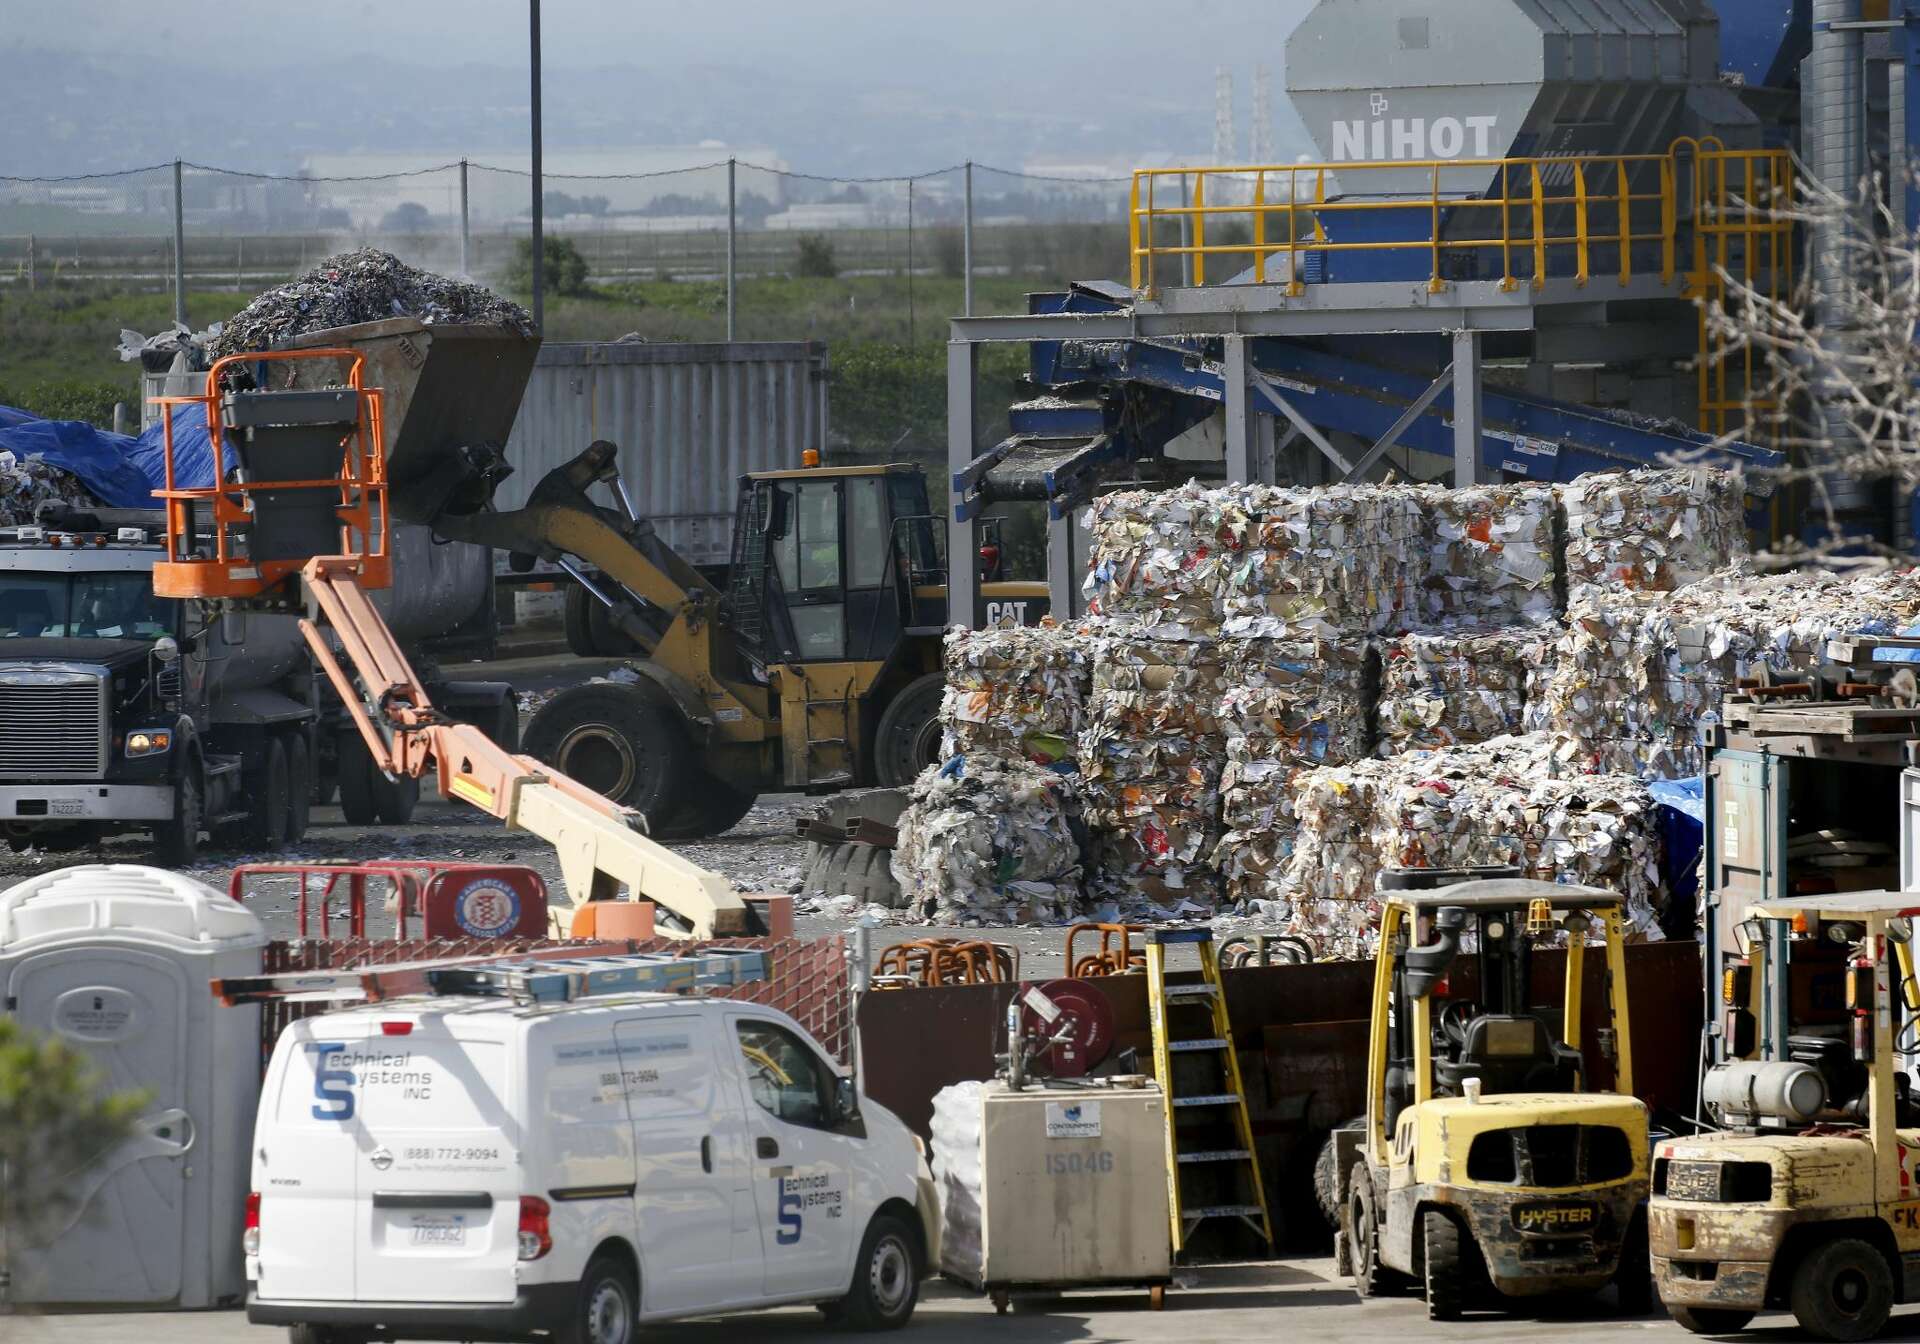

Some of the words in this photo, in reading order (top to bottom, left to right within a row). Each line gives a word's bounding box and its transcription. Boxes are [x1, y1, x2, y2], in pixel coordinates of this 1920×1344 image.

[987, 602, 1027, 627] CAT
[403, 1088, 431, 1100] INC
[437, 1147, 499, 1160] 772-9094
[1520, 1207, 1592, 1224] HYSTER
